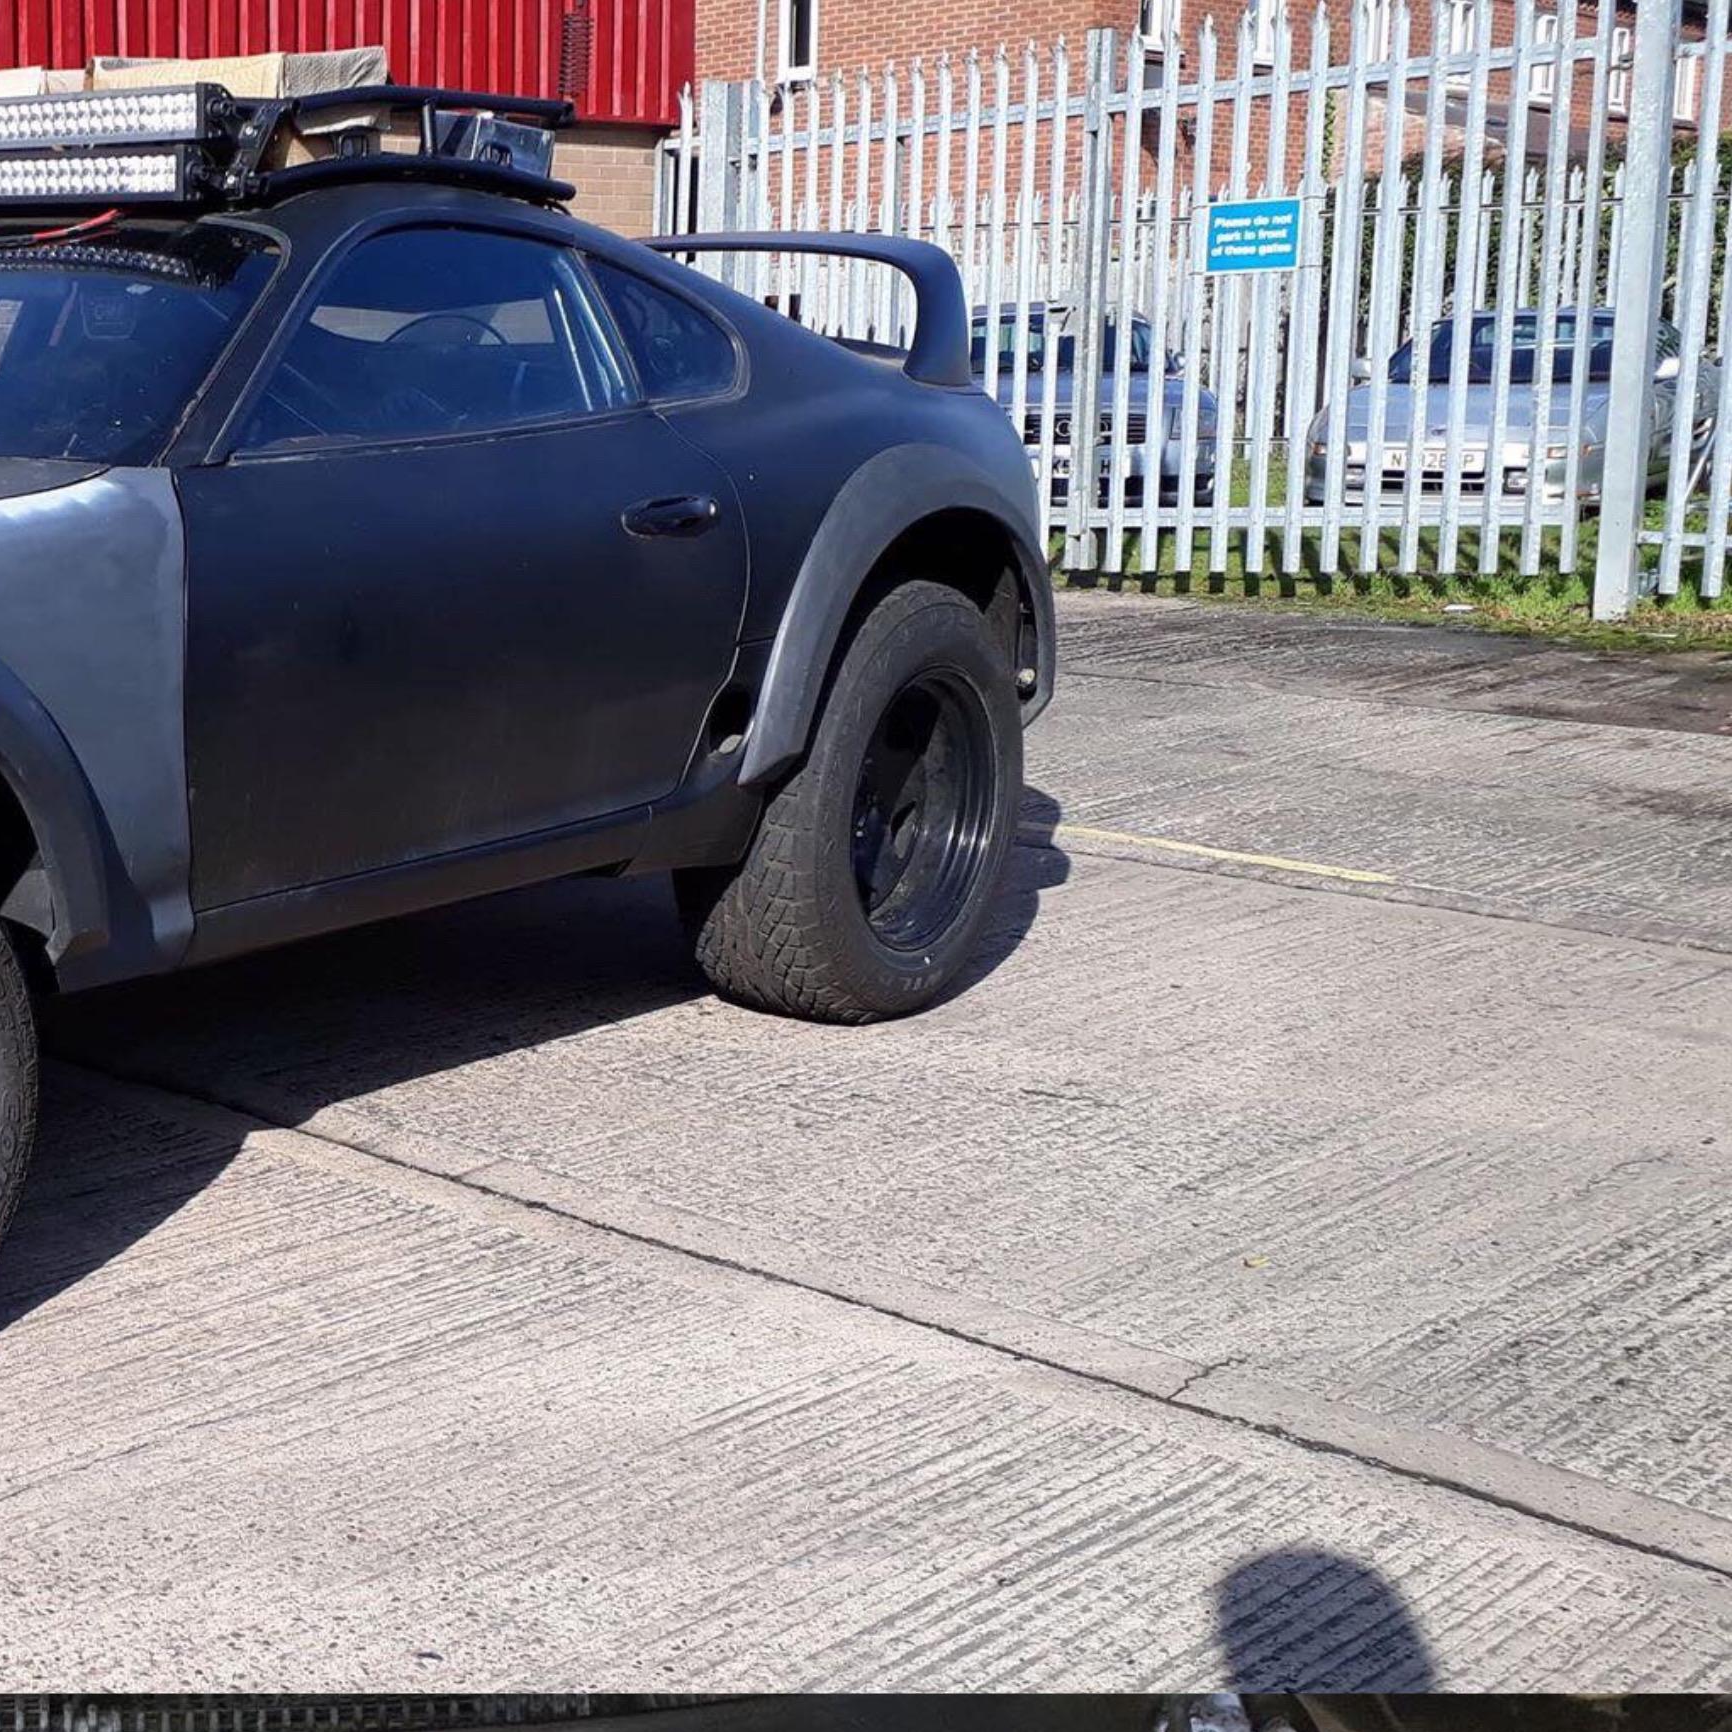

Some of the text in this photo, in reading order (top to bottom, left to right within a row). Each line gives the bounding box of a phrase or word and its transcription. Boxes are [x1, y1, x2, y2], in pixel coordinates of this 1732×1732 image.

[1214, 213, 1293, 228] Please do not
[1216, 231, 1241, 245] park
[1258, 229, 1287, 240] front
[1224, 245, 1256, 256] these
